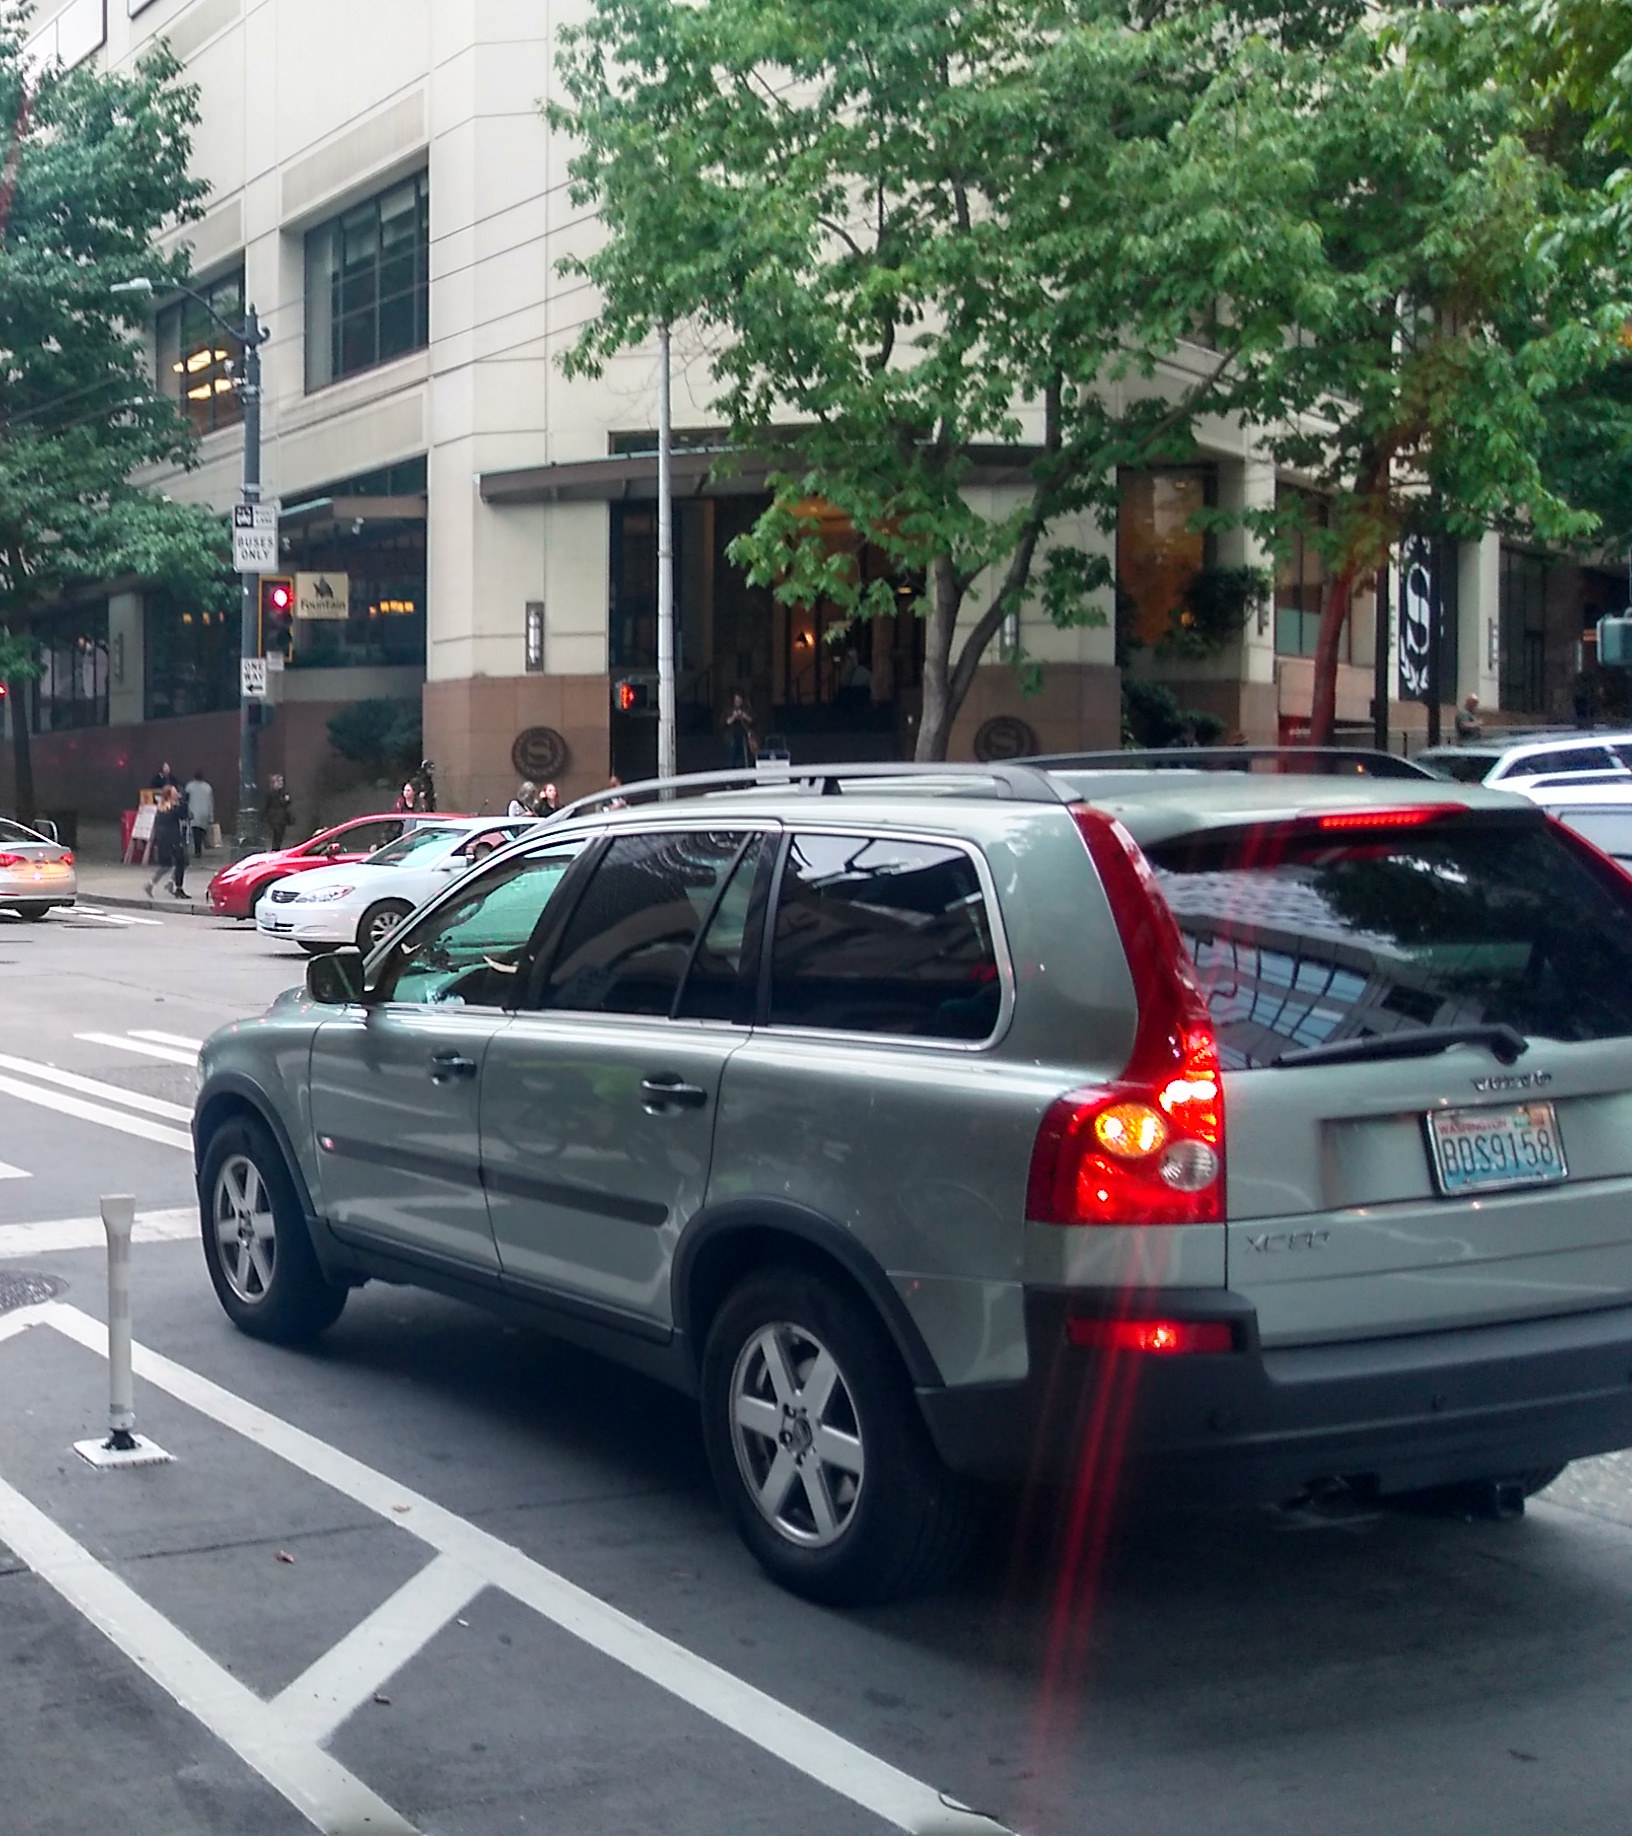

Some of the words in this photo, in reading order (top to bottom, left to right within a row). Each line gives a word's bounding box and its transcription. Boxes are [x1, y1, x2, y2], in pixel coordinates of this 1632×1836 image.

[238, 535, 274, 548] BUSES
[241, 549, 269, 560] ONLY
[244, 662, 262, 671] ONE
[244, 673, 262, 681] WAY
